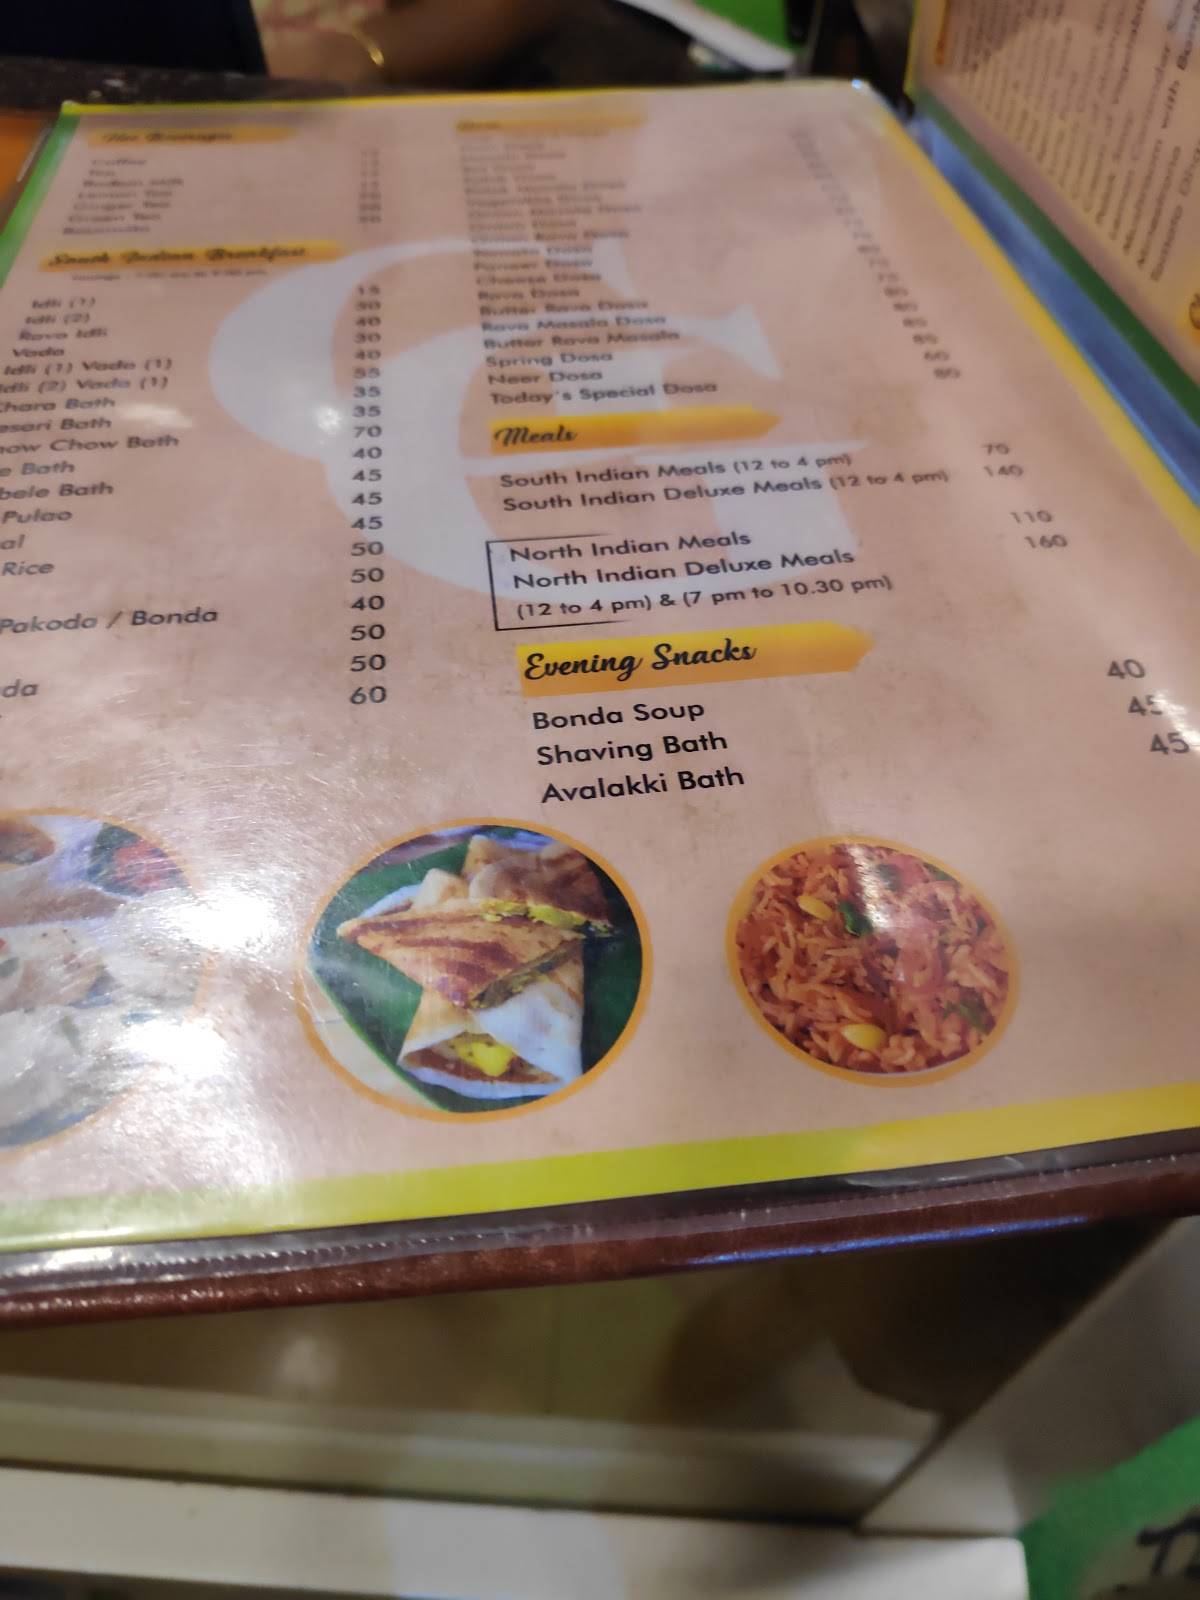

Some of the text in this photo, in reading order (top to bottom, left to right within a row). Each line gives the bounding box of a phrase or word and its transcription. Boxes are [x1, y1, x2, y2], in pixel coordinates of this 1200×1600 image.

[485, 351, 614, 369] Spring Dosa
[488, 369, 603, 385] Neer Dosa
[579, 384, 657, 403] Special
[662, 380, 718, 395] Dosa
[352, 405, 382, 418] 35
[60, 417, 112, 431] Bath
[353, 425, 383, 438] 70
[50, 438, 119, 451] Chow
[126, 434, 180, 449] Bath
[494, 424, 578, 447] Meals
[352, 446, 384, 460] 40
[21, 460, 76, 476] Bath
[352, 468, 383, 482] 45
[501, 453, 853, 488] South Indian Meals (12 to 4 pm)
[59, 481, 115, 497] Bath
[503, 469, 950, 512] South Indian Deluxe Meals (12 to 4 pm)
[351, 492, 384, 506] 45
[1, 508, 73, 525] Pulao
[351, 515, 384, 530] 45
[1009, 509, 1053, 525] 110
[350, 541, 385, 557] 50
[510, 531, 752, 562] North Indian Meals
[1024, 533, 1069, 549] 160
[1, 560, 55, 577] Rice
[350, 567, 385, 584] 50
[513, 549, 855, 589] North Indian Deluxe Meals
[350, 594, 386, 612] 40
[517, 574, 894, 621] (12 to 4 pm) & (7 pm to 10.30 pm)
[0, 613, 98, 635] Pakoda
[131, 606, 219, 626] Bonda
[350, 624, 386, 641] 50
[350, 653, 387, 672] 50
[524, 638, 758, 683] Evening Snacks
[1107, 658, 1146, 680] 40
[350, 685, 388, 705] 60
[532, 702, 706, 731] Bonda Soup
[536, 730, 728, 766] Shaving Bath
[1150, 731, 1191, 755] 45
[541, 766, 745, 804] Avalakki Bath
